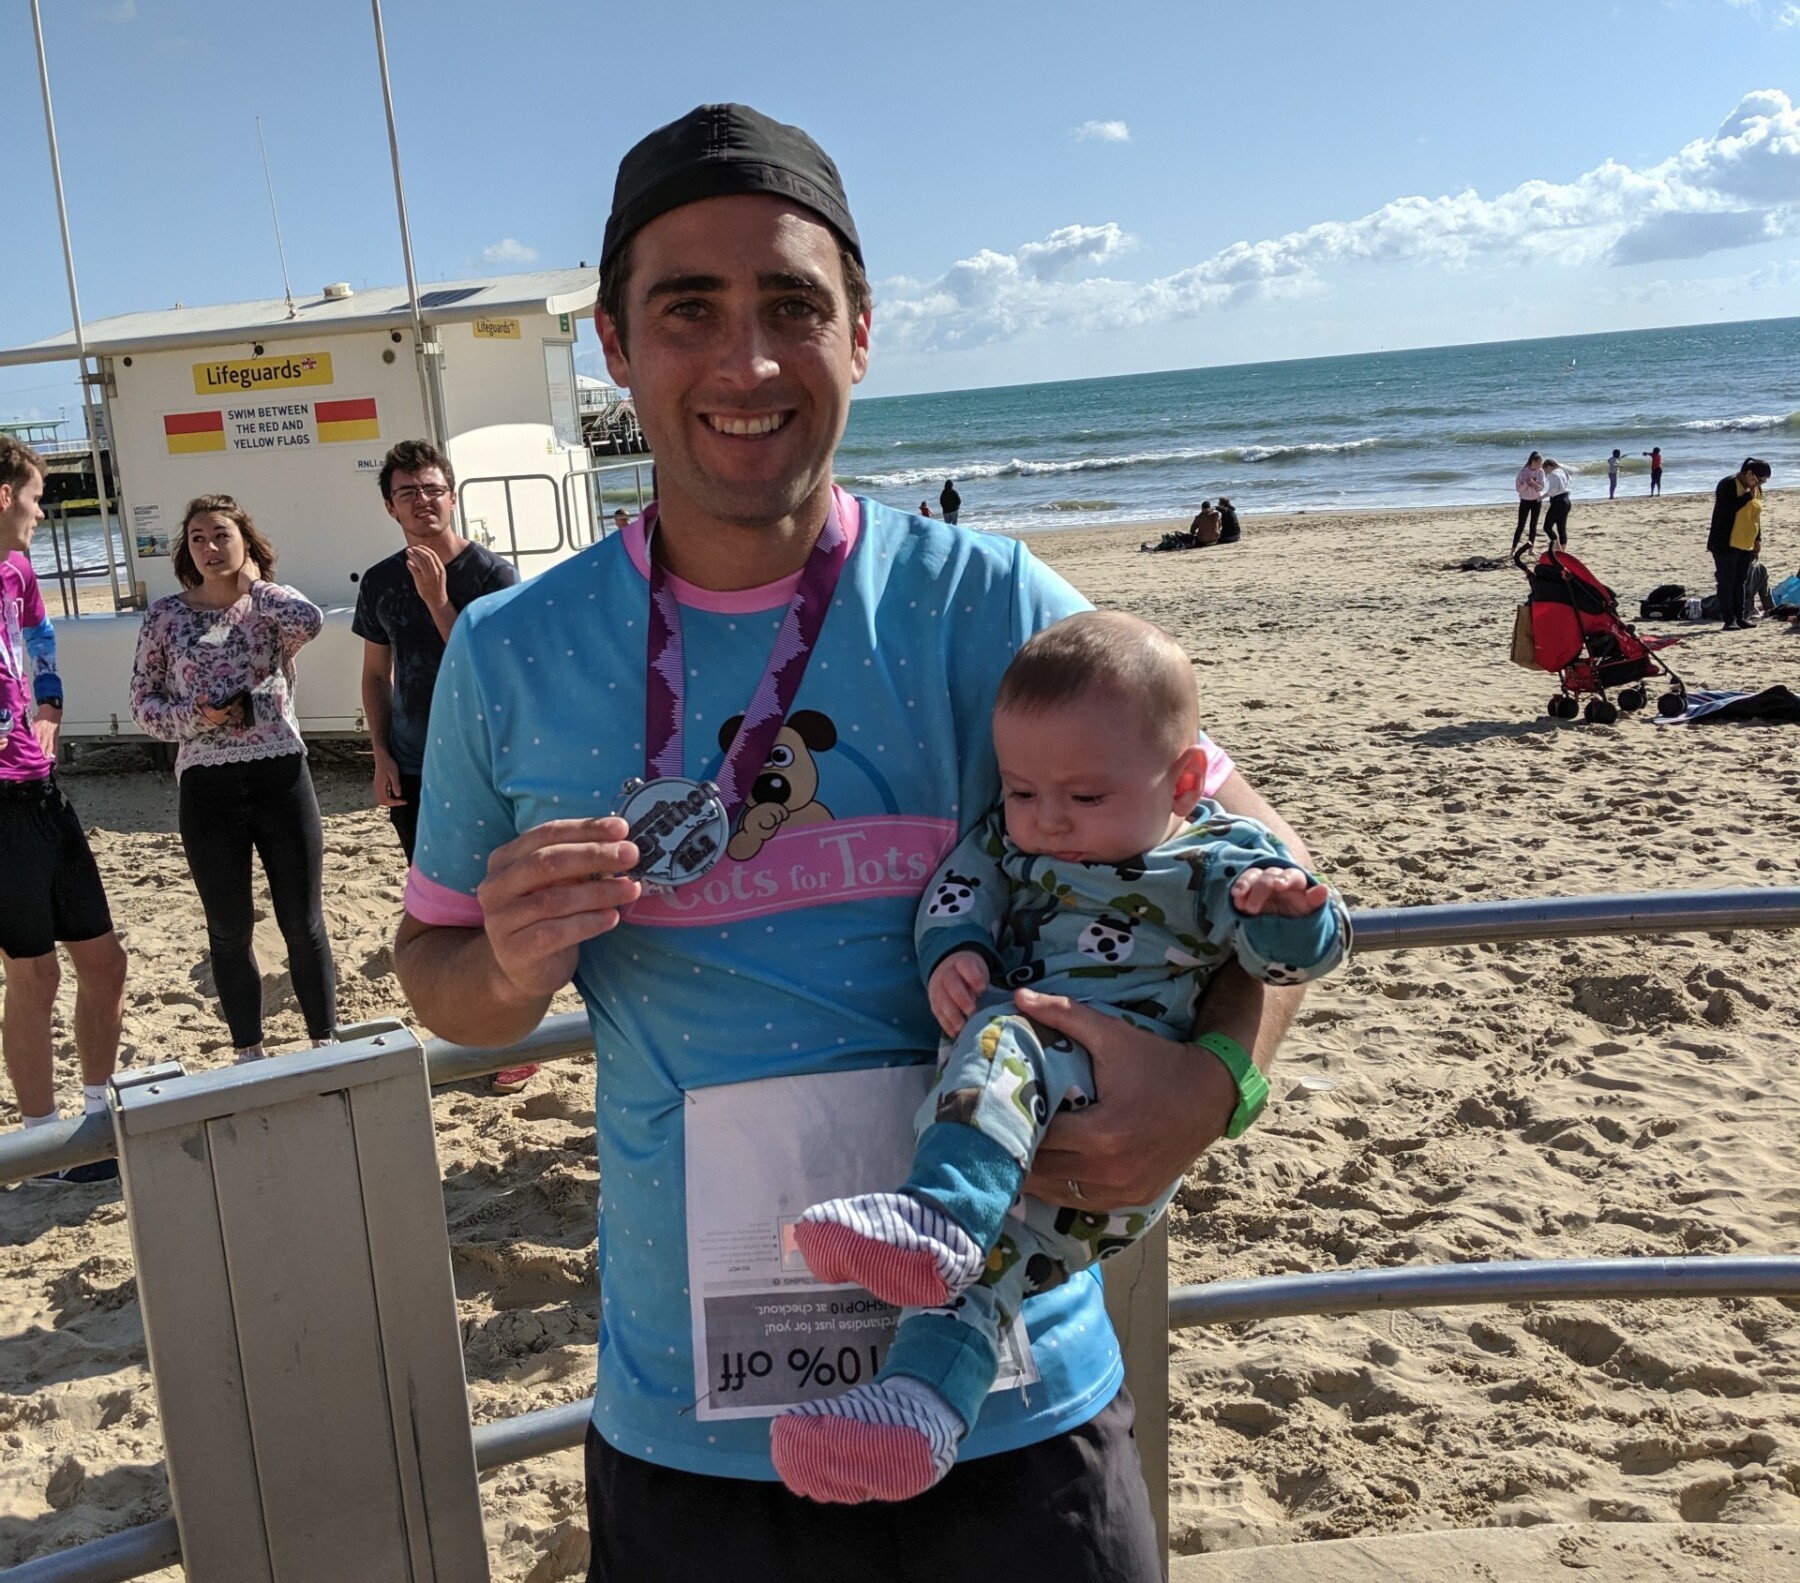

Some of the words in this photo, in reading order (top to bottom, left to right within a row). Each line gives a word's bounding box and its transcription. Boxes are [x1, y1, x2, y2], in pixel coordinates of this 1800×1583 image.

[477, 320, 510, 336] Lifeguards
[206, 360, 302, 388] Lifeguards
[228, 408, 256, 420] SWIM
[258, 404, 309, 418] BETWEEN
[236, 423, 256, 434] THE
[259, 421, 279, 433] RED
[281, 420, 304, 431] AND
[233, 437, 275, 449] YELLOW
[277, 434, 310, 446] FLAGS
[634, 782, 719, 857] arathon
[788, 863, 830, 891] for
[818, 830, 928, 888] Tots
[755, 1303, 813, 1316] checkout.
[816, 1303, 828, 1313] at
[765, 1319, 791, 1336] you!
[794, 1322, 812, 1334] for
[814, 1319, 836, 1332] just
[838, 1317, 898, 1332] rchandise
[718, 1350, 773, 1392] off
[787, 1345, 879, 1388] 10%
